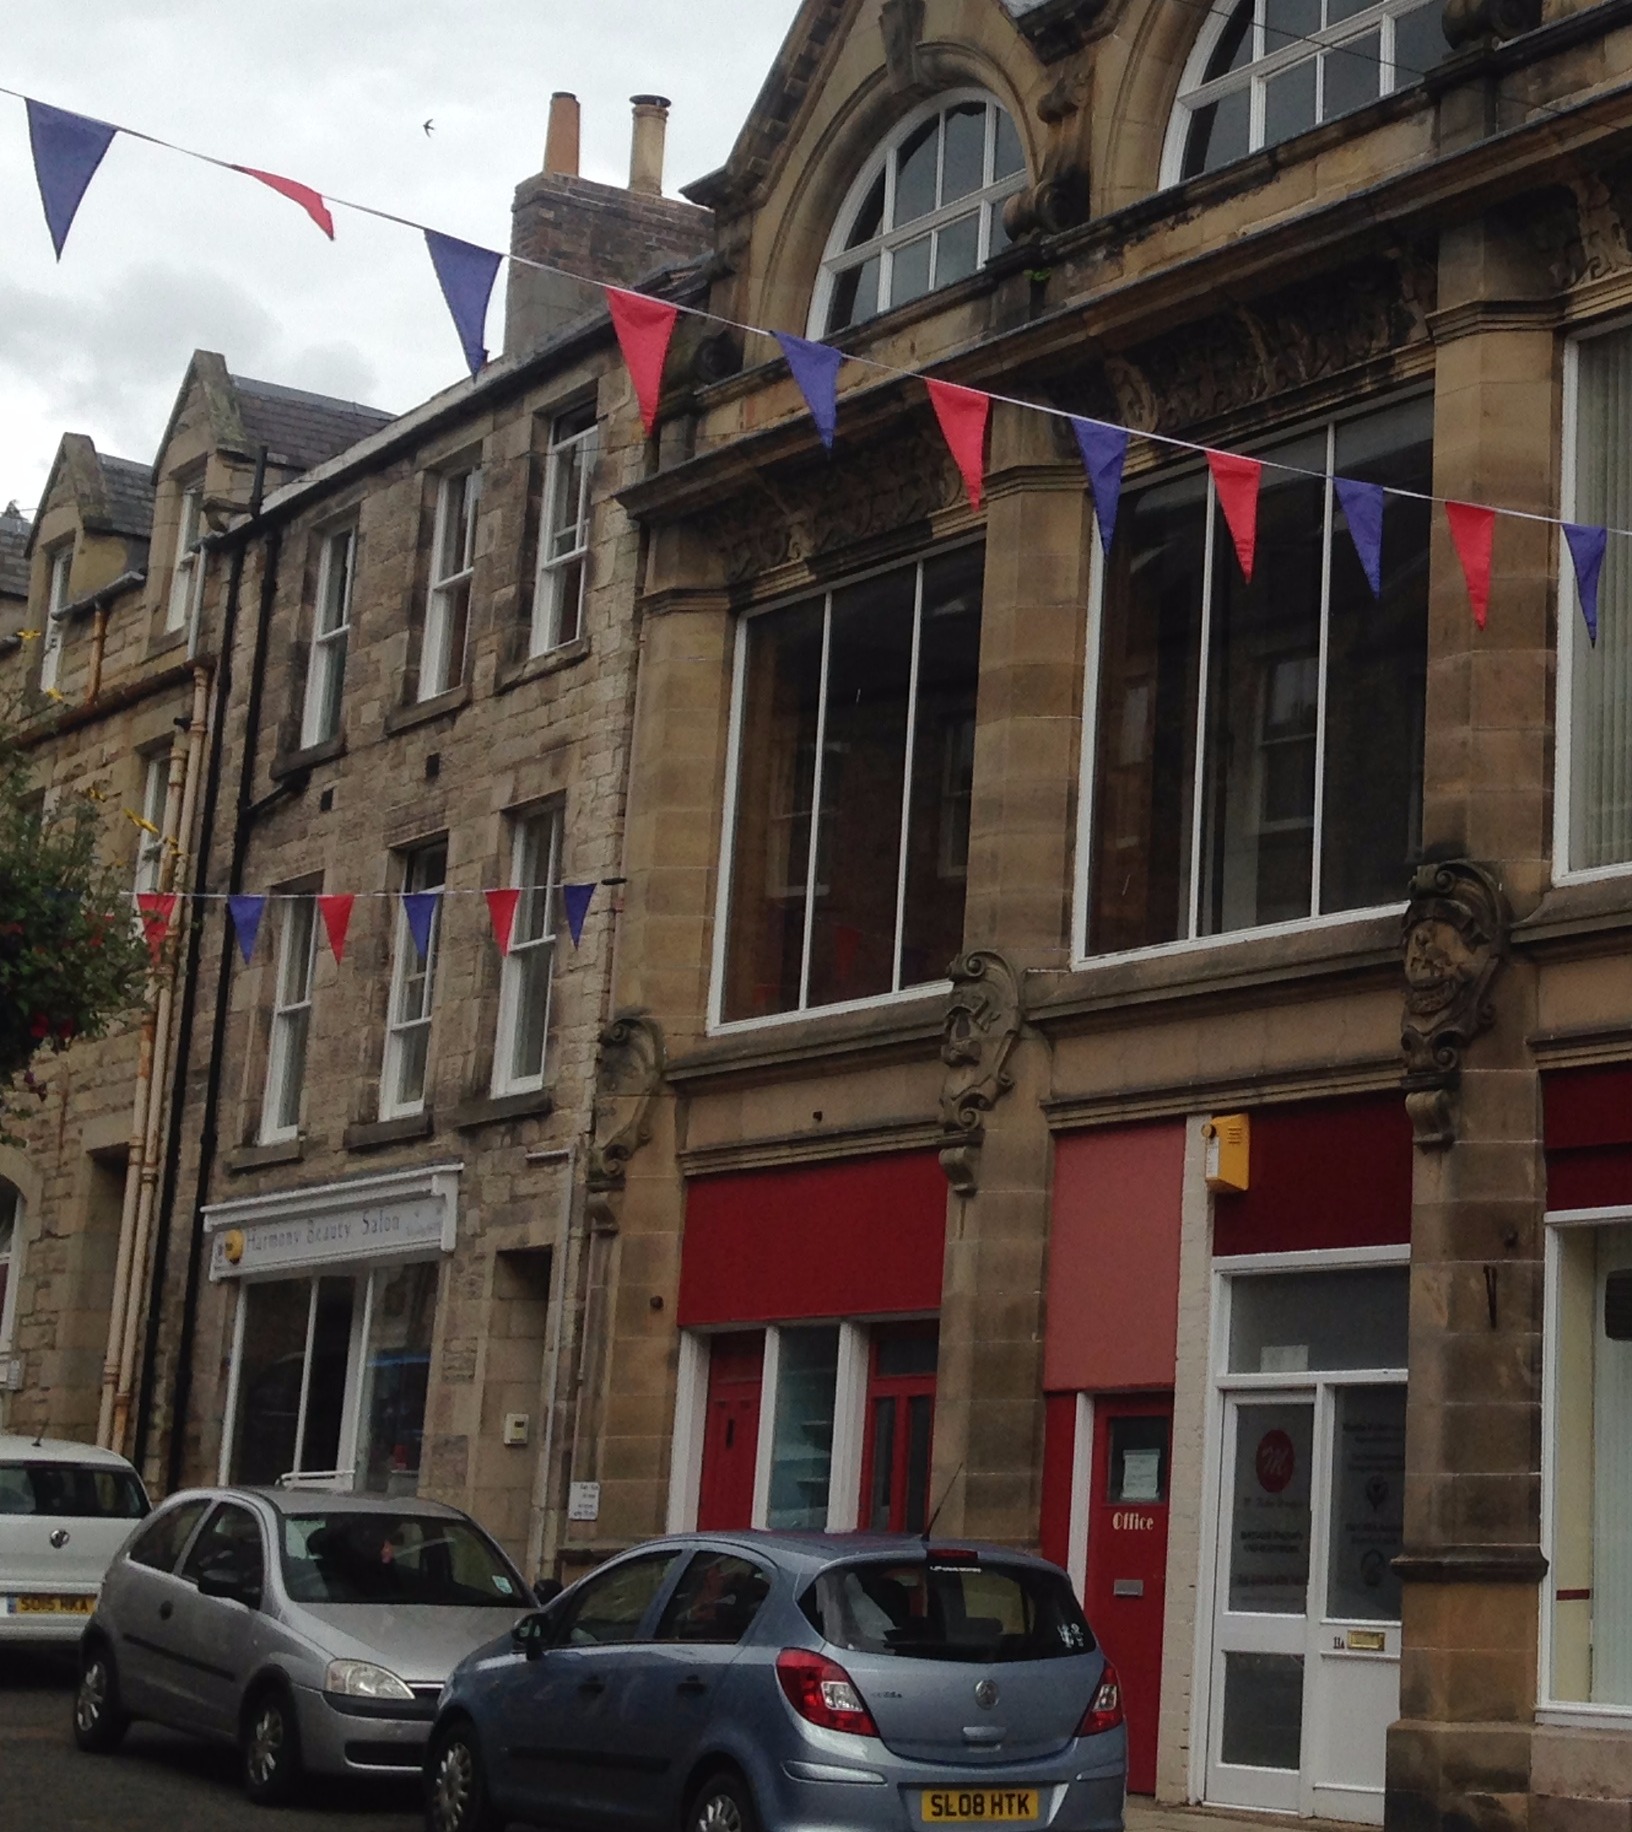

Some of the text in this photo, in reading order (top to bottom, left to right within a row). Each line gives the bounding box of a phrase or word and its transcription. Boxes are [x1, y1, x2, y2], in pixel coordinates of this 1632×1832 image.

[306, 1219, 352, 1244] Beauty
[362, 1209, 400, 1236] Salon
[1112, 1511, 1154, 1531] Office
[931, 1793, 1030, 1817] SL08 HTK
